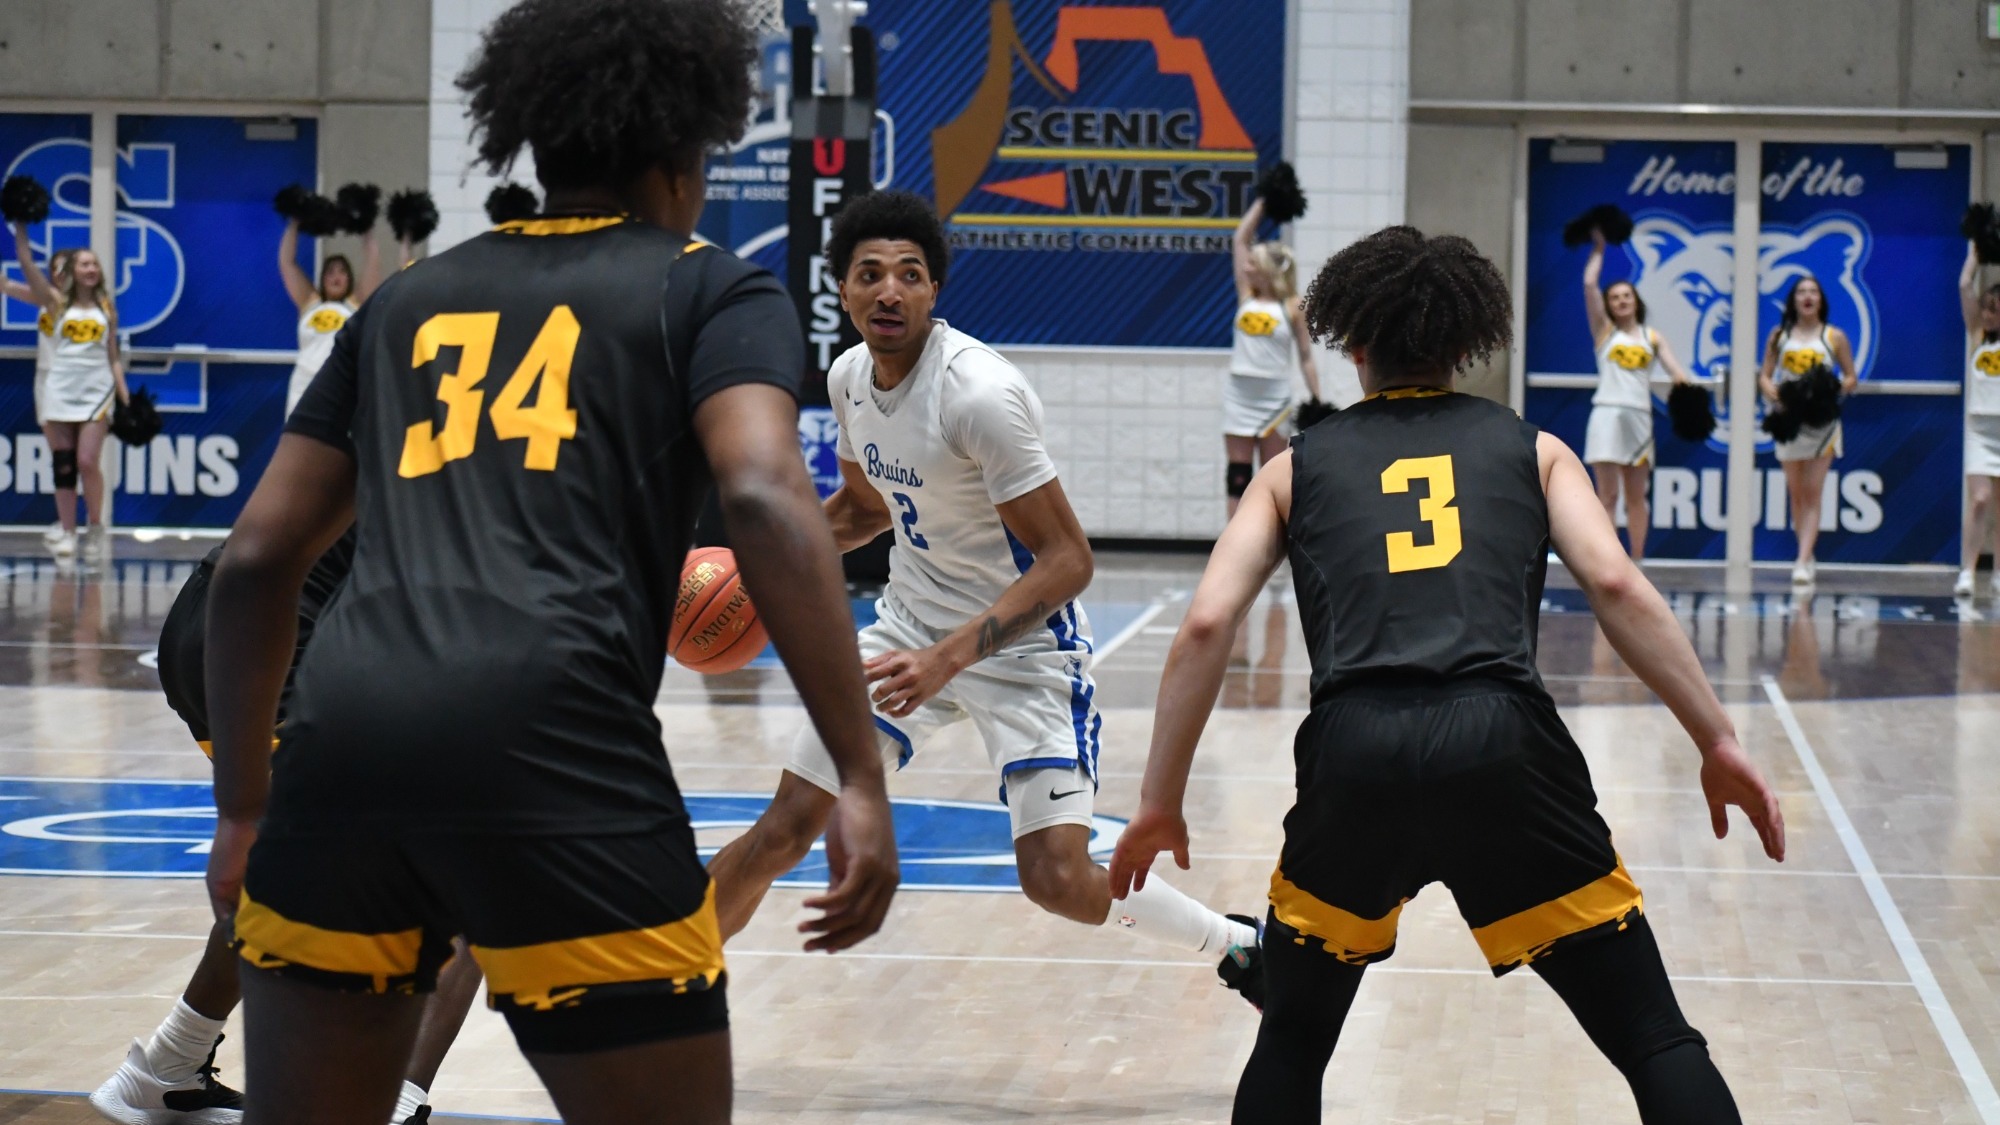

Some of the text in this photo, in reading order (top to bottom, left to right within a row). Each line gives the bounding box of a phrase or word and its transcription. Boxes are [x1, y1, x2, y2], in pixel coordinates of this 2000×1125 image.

[1005, 107, 1197, 147] SCENIC
[1069, 164, 1256, 218] WEST
[1627, 156, 1865, 202] Home of the
[950, 231, 1072, 251] ATHLETIC
[398, 304, 583, 479] 34
[863, 442, 924, 489] Bruins
[891, 491, 931, 551] 2
[1380, 453, 1463, 574] 3
[673, 562, 726, 625] LEGACY
